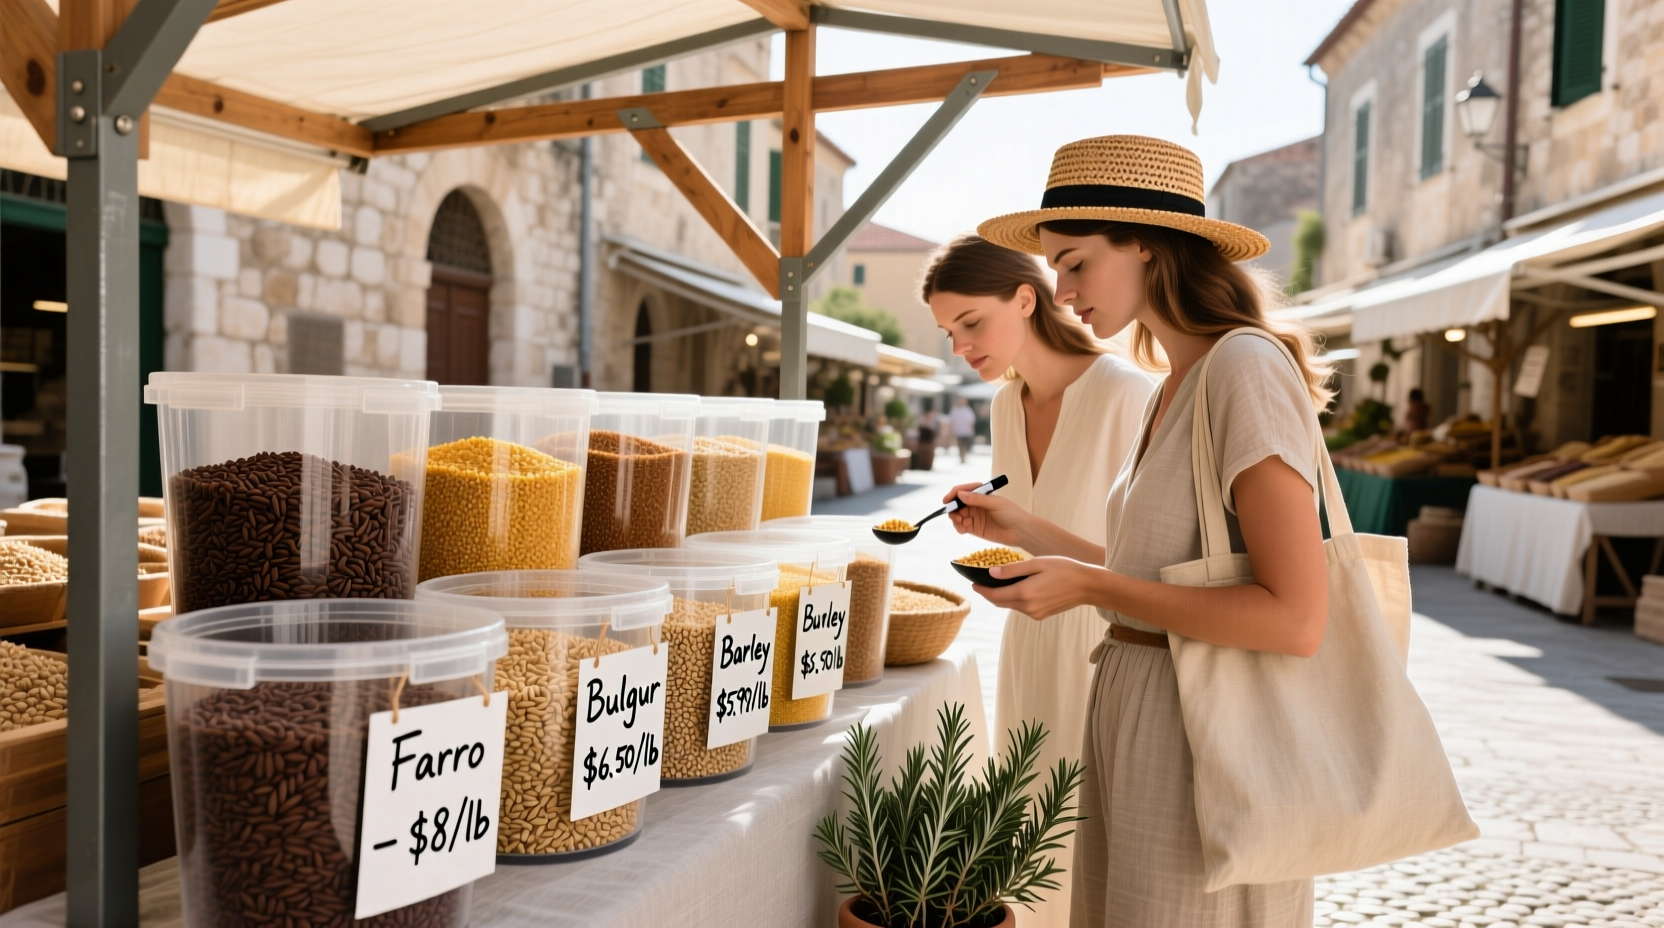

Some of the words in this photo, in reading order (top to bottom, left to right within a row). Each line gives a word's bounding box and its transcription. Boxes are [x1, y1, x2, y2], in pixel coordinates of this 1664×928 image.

[802, 601, 846, 640] Burley
[720, 633, 771, 675] Barley
[587, 674, 661, 729] Bulgur
[391, 729, 485, 791] Farro
[583, 732, 659, 790] $6.50/lb
[409, 796, 490, 866] $8/lb
